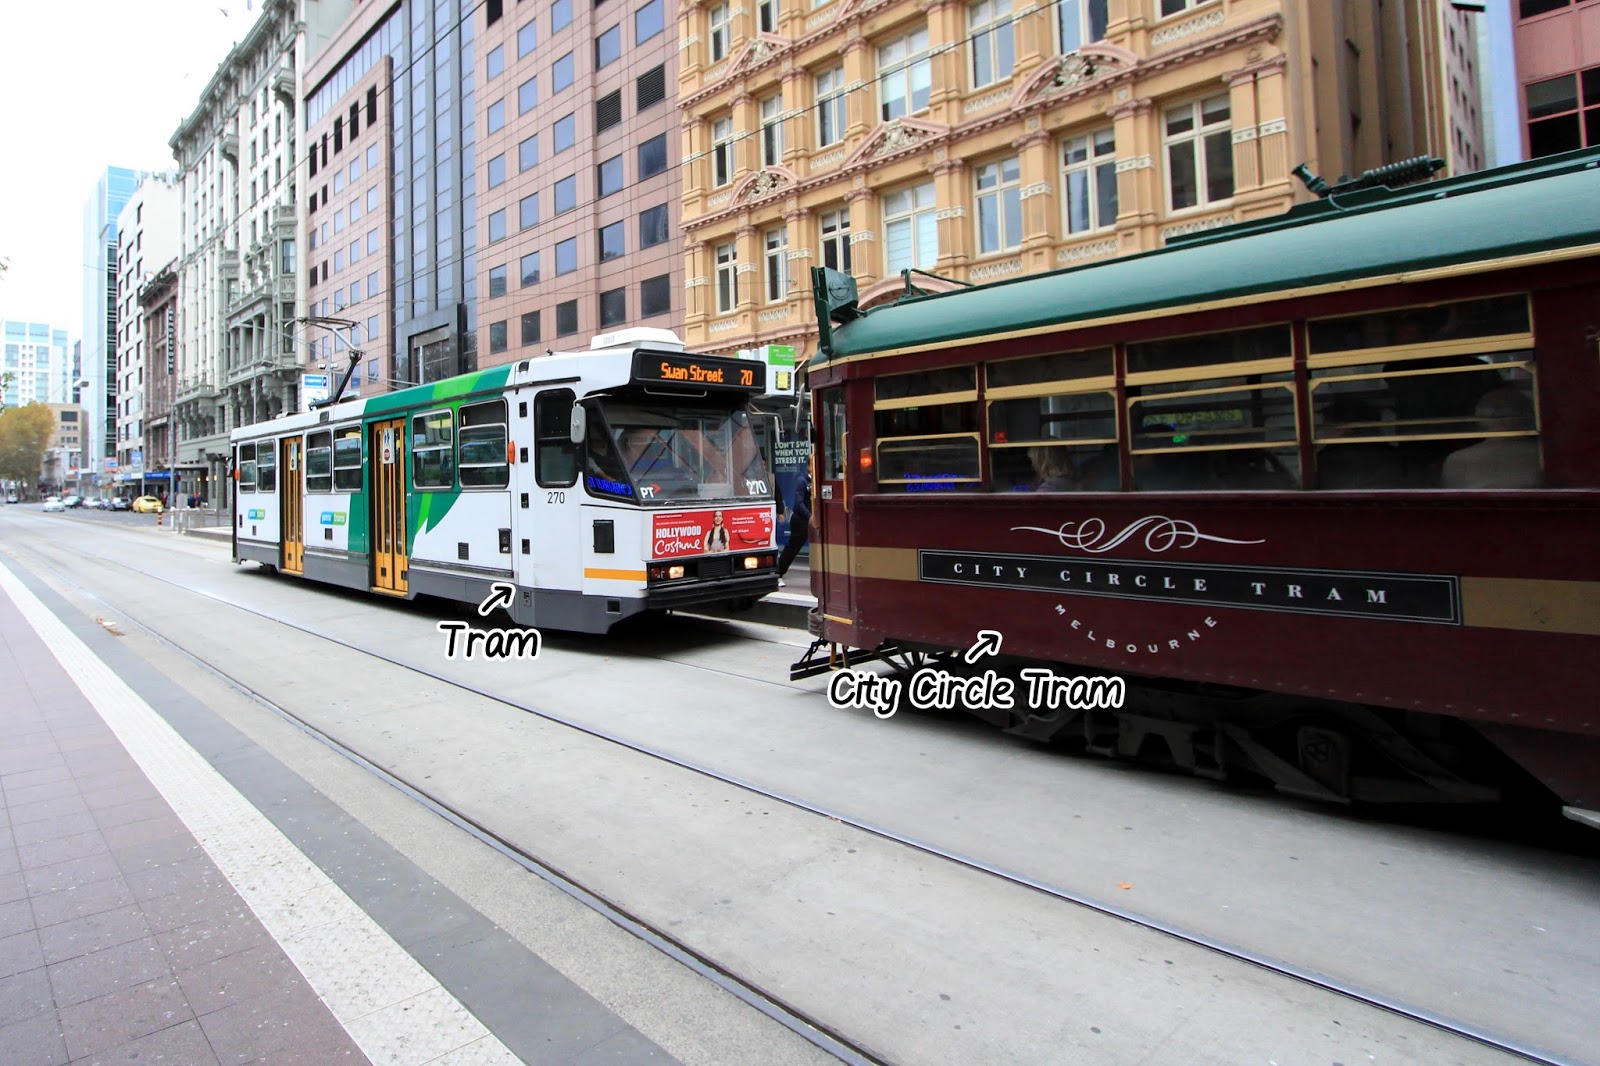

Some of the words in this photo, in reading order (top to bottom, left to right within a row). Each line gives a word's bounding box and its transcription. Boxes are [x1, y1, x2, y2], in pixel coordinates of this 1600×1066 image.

[660, 362, 688, 380] Swan
[689, 365, 723, 383] Street
[740, 369, 753, 386] 70
[775, 449, 794, 457] WHEN
[795, 448, 809, 456] YOU
[775, 456, 797, 465] STRESS
[798, 456, 807, 464] IT.
[640, 486, 654, 499] PT
[746, 479, 767, 495] 270
[547, 491, 565, 504] 270
[655, 525, 702, 539] HOLLYWOOD
[654, 536, 703, 555] Costume
[953, 562, 1028, 579] CITY
[1059, 569, 1207, 592] CIRCLE
[1251, 582, 1387, 604] TRAM
[1054, 603, 1217, 654] MELBOURNE
